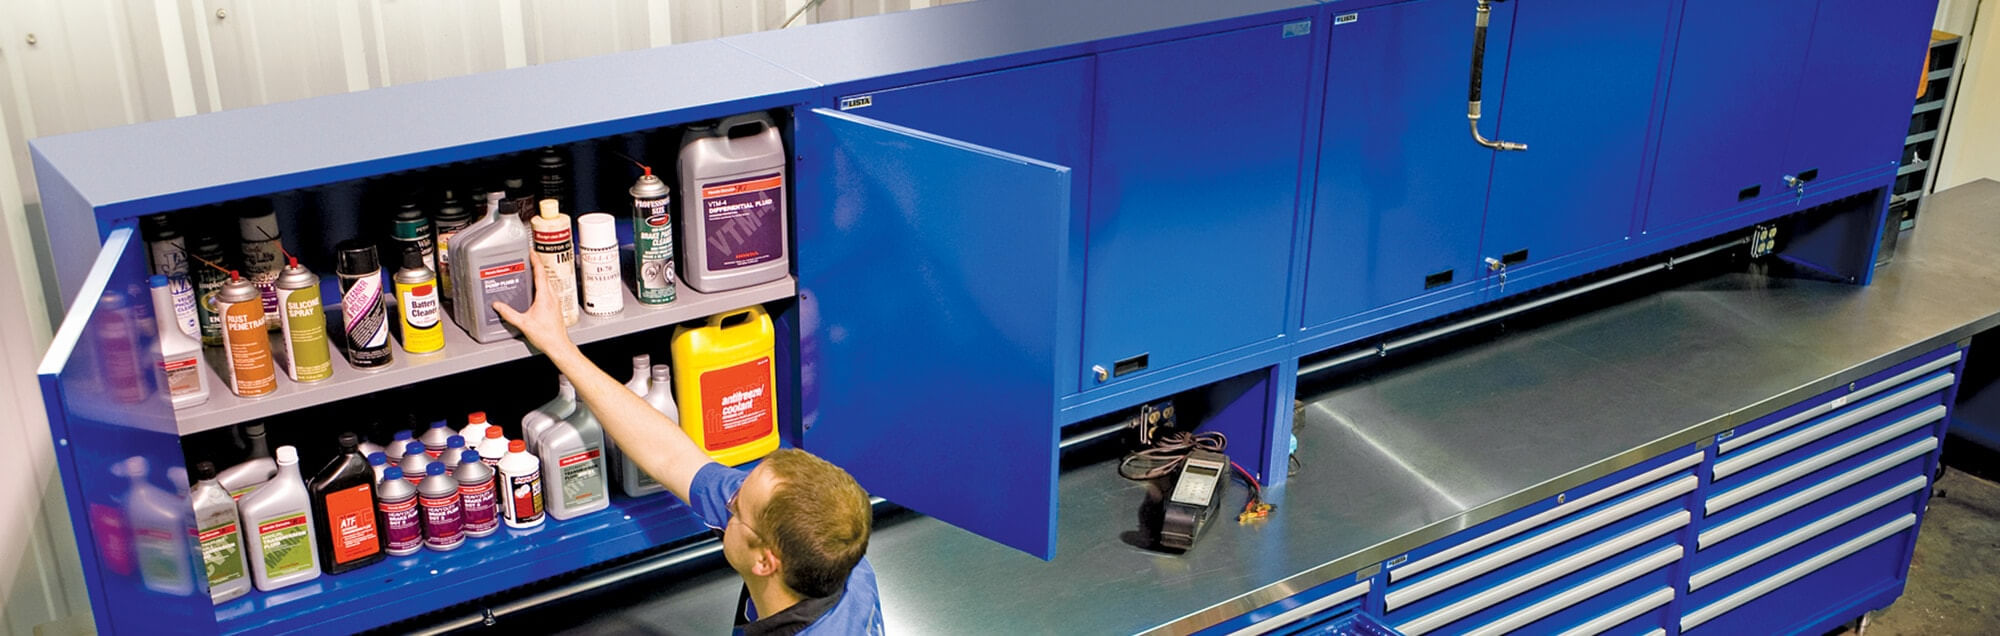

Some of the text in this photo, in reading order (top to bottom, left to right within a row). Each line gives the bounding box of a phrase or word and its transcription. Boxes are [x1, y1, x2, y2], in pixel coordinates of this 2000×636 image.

[848, 97, 870, 108] LISTA
[708, 200, 727, 208] VTM-4
[709, 199, 773, 214] DIFFERENTIAL FLUID
[411, 300, 436, 311] Battery
[289, 308, 314, 318] SPRAY
[411, 307, 437, 318] Cleaner
[227, 314, 248, 323] RUST
[722, 399, 753, 416] coolant
[340, 516, 357, 529] ATF
